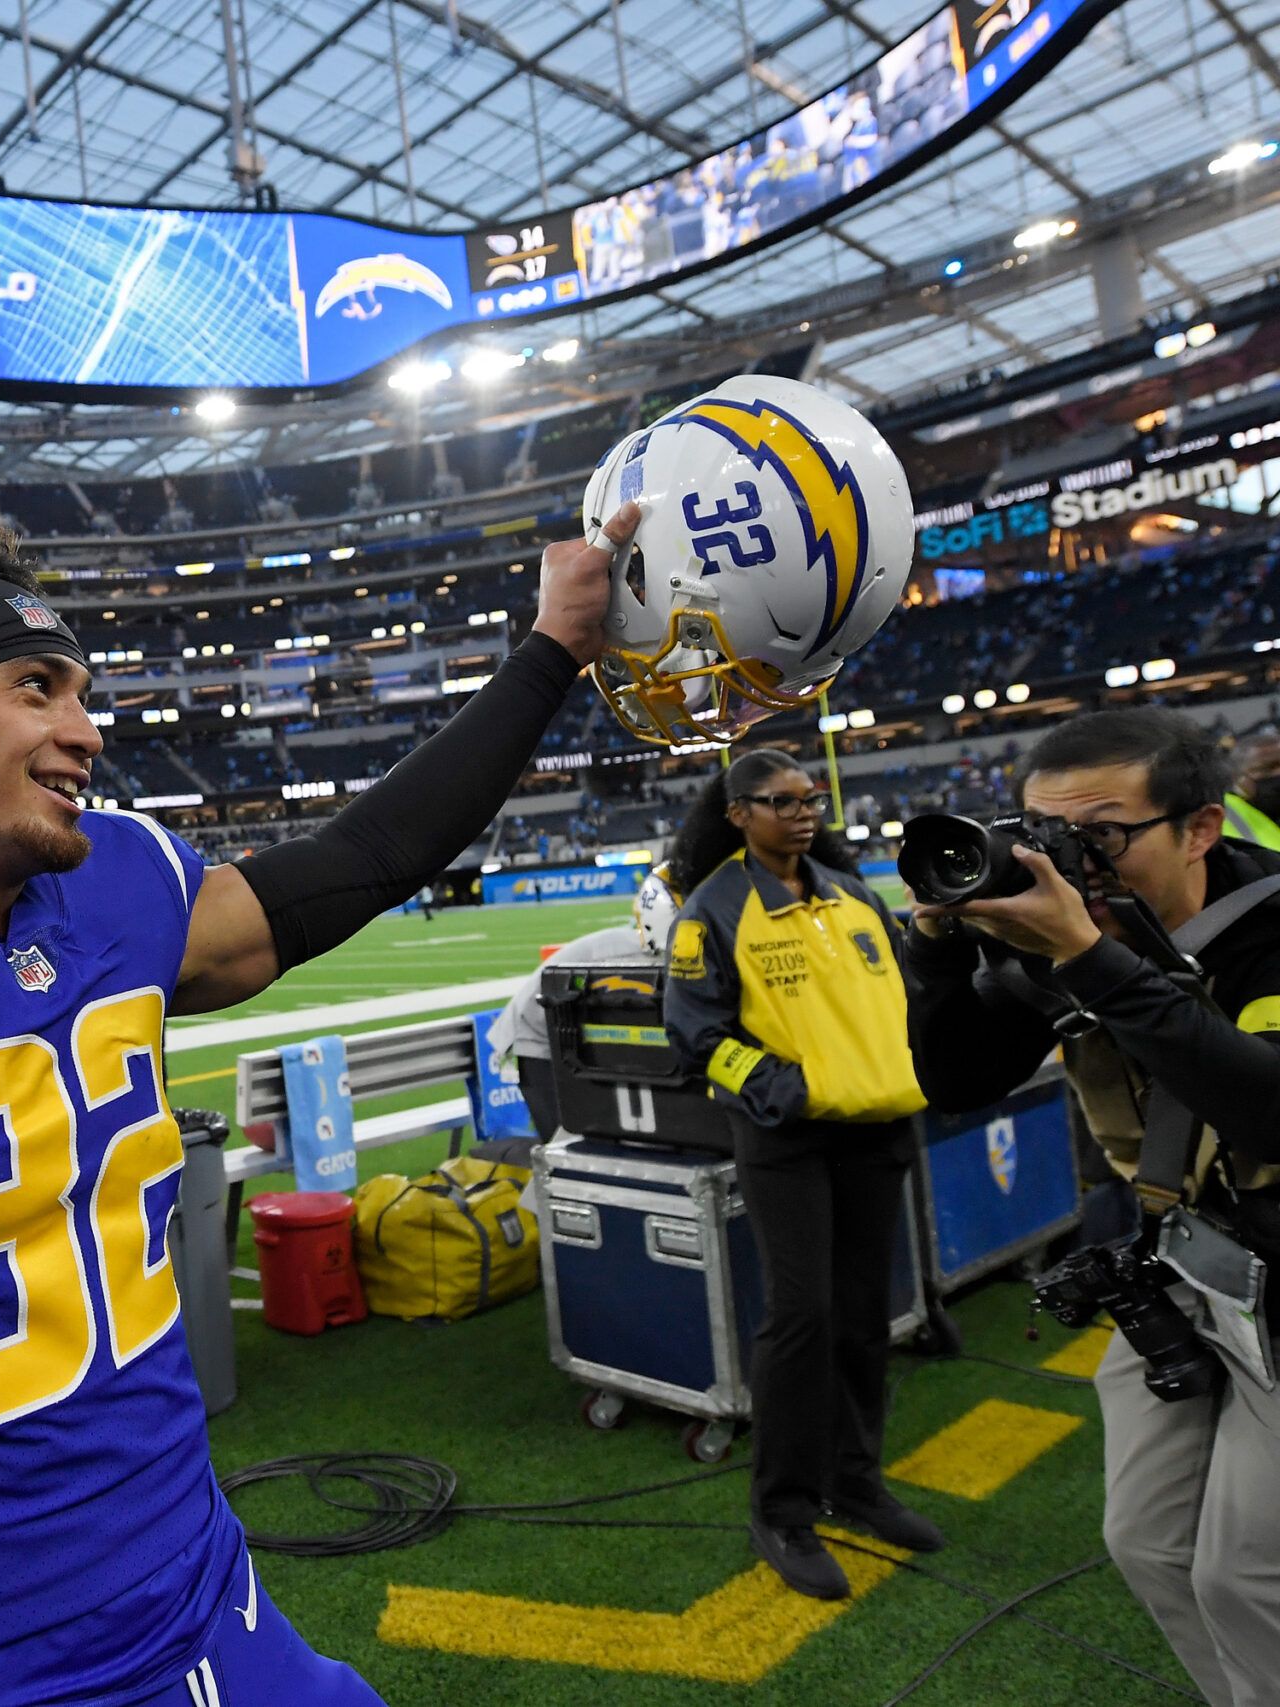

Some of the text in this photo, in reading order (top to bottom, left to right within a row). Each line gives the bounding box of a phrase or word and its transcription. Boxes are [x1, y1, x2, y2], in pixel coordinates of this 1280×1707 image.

[921, 511, 1004, 559] SoFi
[1051, 457, 1238, 529] Stadium
[682, 480, 777, 577] 32
[749, 939, 805, 952] SECURITY
[19, 963, 50, 985] NFL
[762, 953, 806, 974] 2109
[765, 973, 809, 988] STAFF
